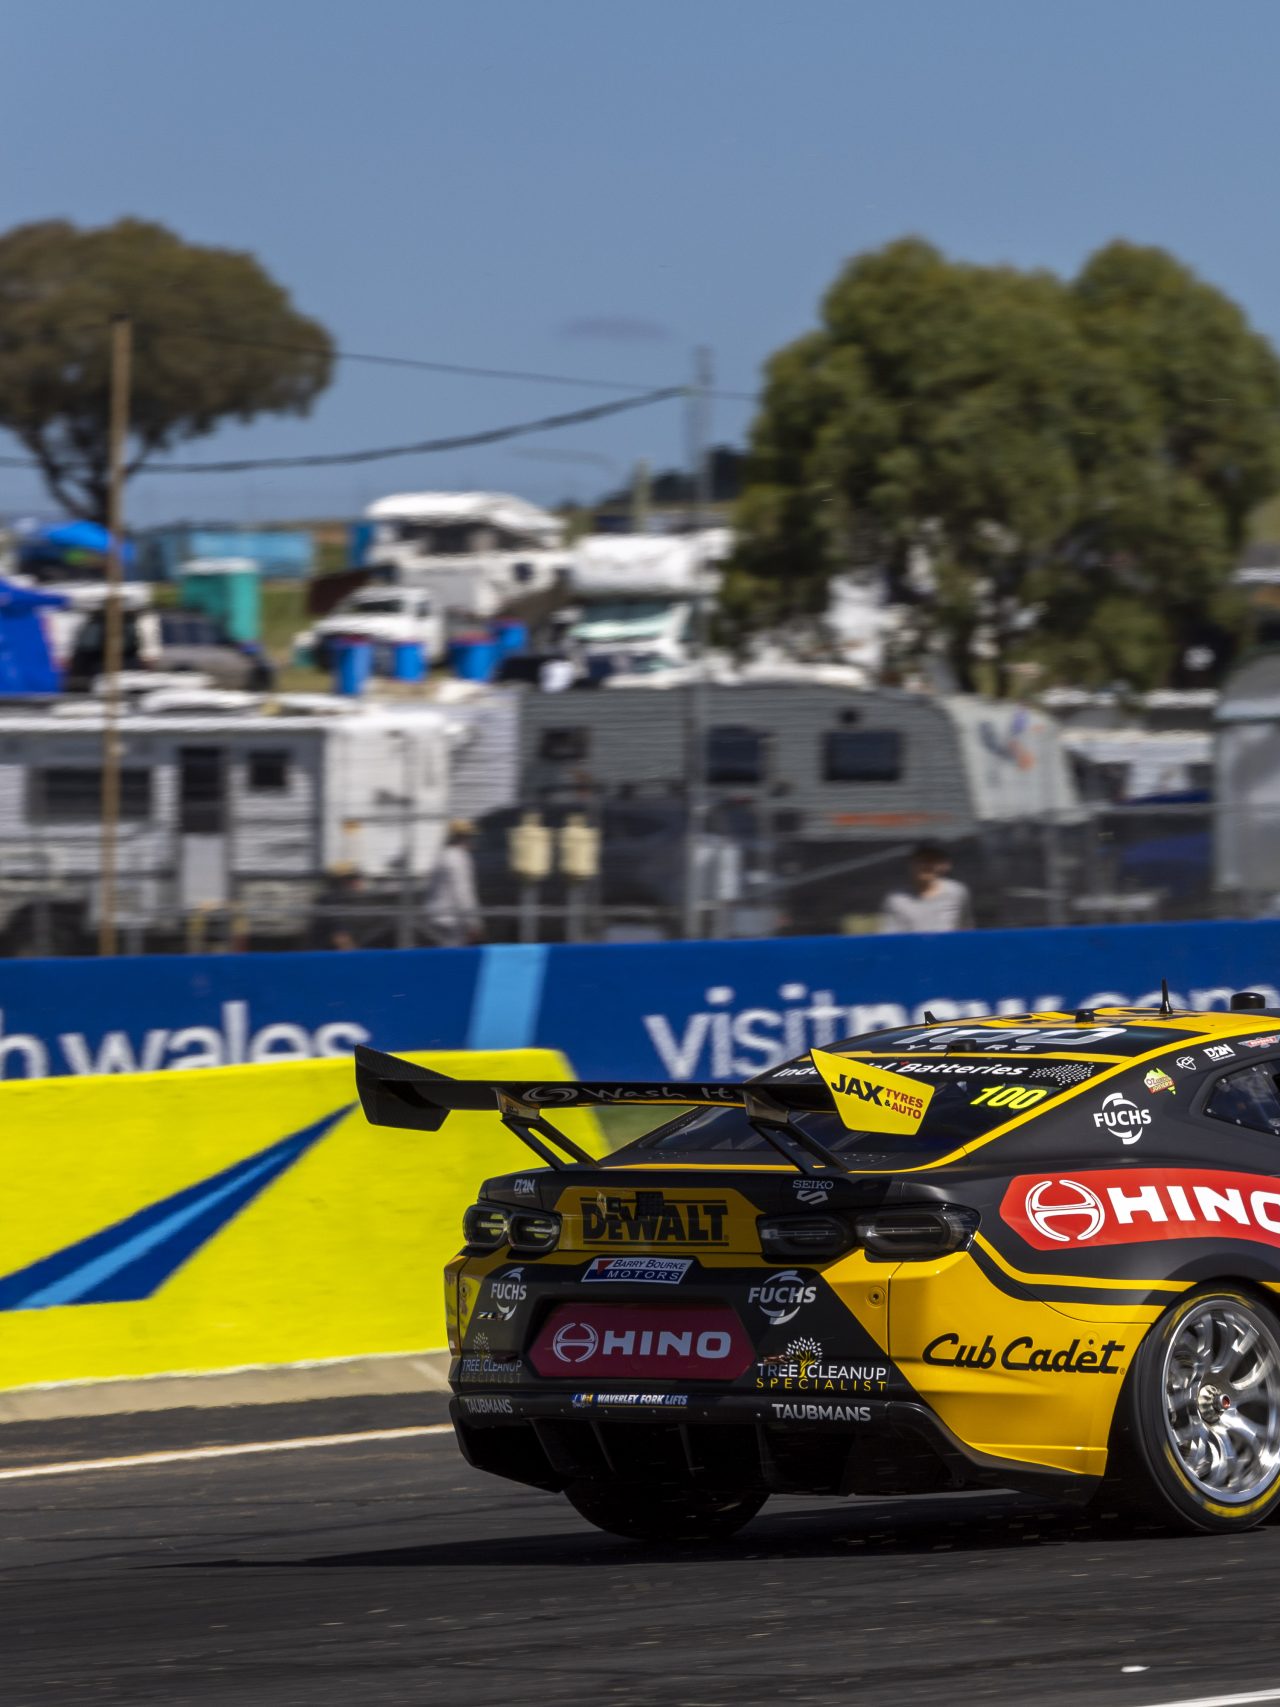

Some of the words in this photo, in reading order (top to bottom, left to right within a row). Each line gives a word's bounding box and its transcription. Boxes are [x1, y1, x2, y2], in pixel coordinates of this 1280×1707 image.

[899, 1061, 1028, 1076] Batteries
[581, 1086, 688, 1100] Wash
[831, 1073, 883, 1107] JAX
[885, 1088, 924, 1109] TYRES
[970, 1085, 1049, 1110] 100
[891, 1104, 922, 1120] AUTO
[1093, 1108, 1152, 1128] FUCHS
[792, 1179, 834, 1190] SEIKO
[613, 1259, 645, 1268] BARRY
[646, 1259, 687, 1270] BOURKE
[606, 1270, 681, 1281] MOTORS
[490, 1283, 527, 1301] FUCHS
[748, 1286, 817, 1303] FUCHS
[602, 1330, 732, 1359] HINO
[922, 1333, 996, 1369] Cub
[1001, 1336, 1126, 1374] Cadet
[461, 1359, 480, 1372] TREE
[482, 1359, 523, 1372] CLEANUP
[757, 1363, 799, 1378] TREE
[806, 1365, 887, 1381] CLEANUP
[756, 1377, 887, 1392] SPECIALIST
[464, 1399, 513, 1414] TAUBMANS
[597, 1394, 639, 1405] WAVERLEY
[639, 1395, 664, 1405] FORK
[664, 1395, 688, 1406] LIFTS
[772, 1403, 872, 1422] TAUBMANS
